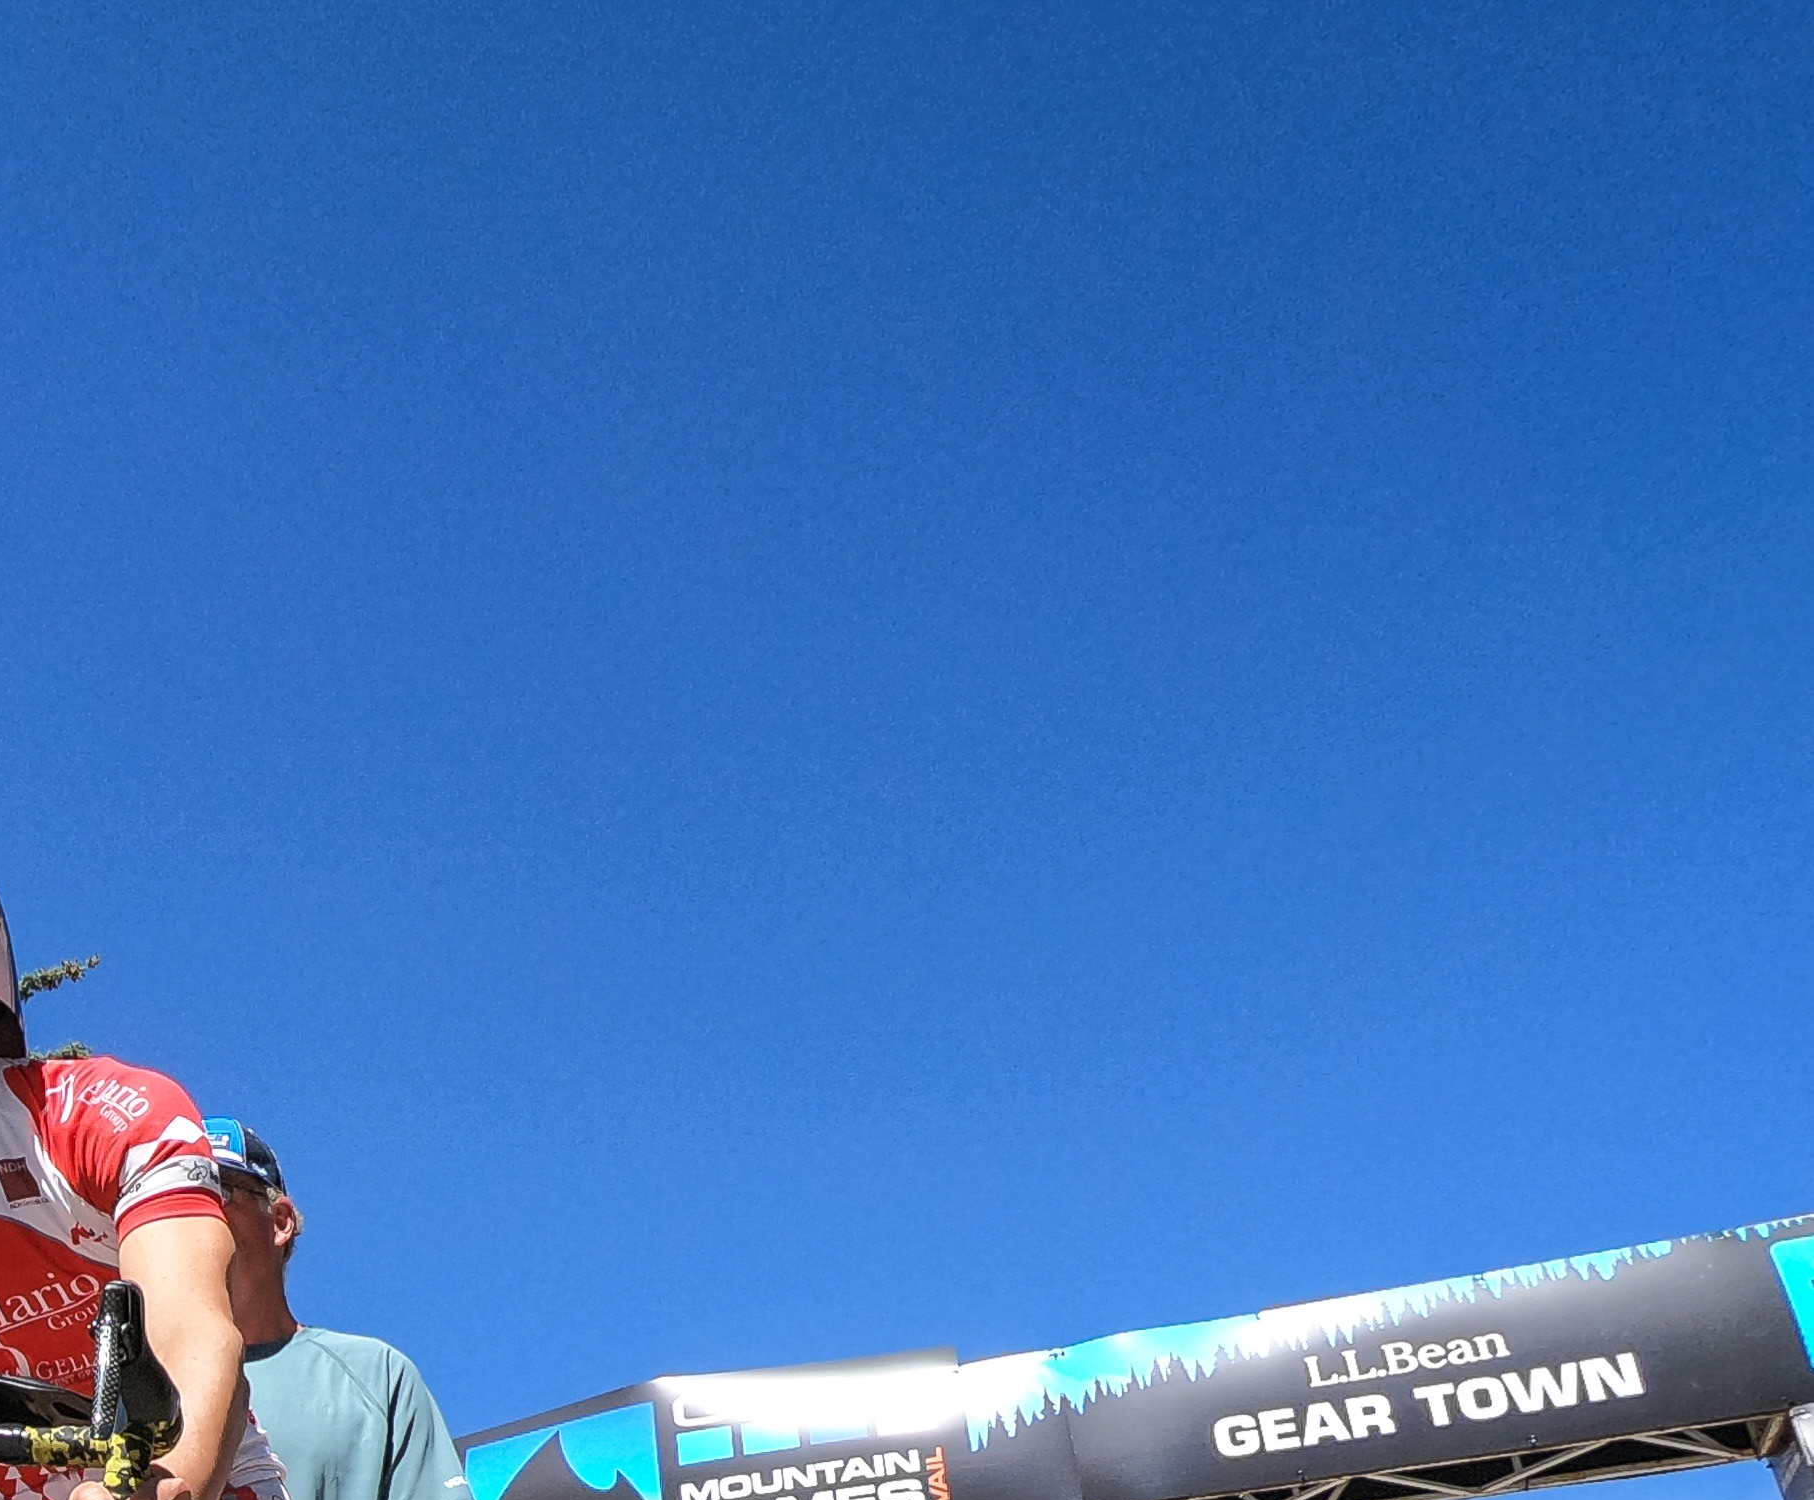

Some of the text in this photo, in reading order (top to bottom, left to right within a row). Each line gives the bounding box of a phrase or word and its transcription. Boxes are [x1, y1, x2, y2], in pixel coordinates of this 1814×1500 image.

[47, 1303, 100, 1331] Grou
[1304, 1332, 1511, 1388] L.L.Bean
[1214, 1353, 1647, 1459] GEAR TOWN
